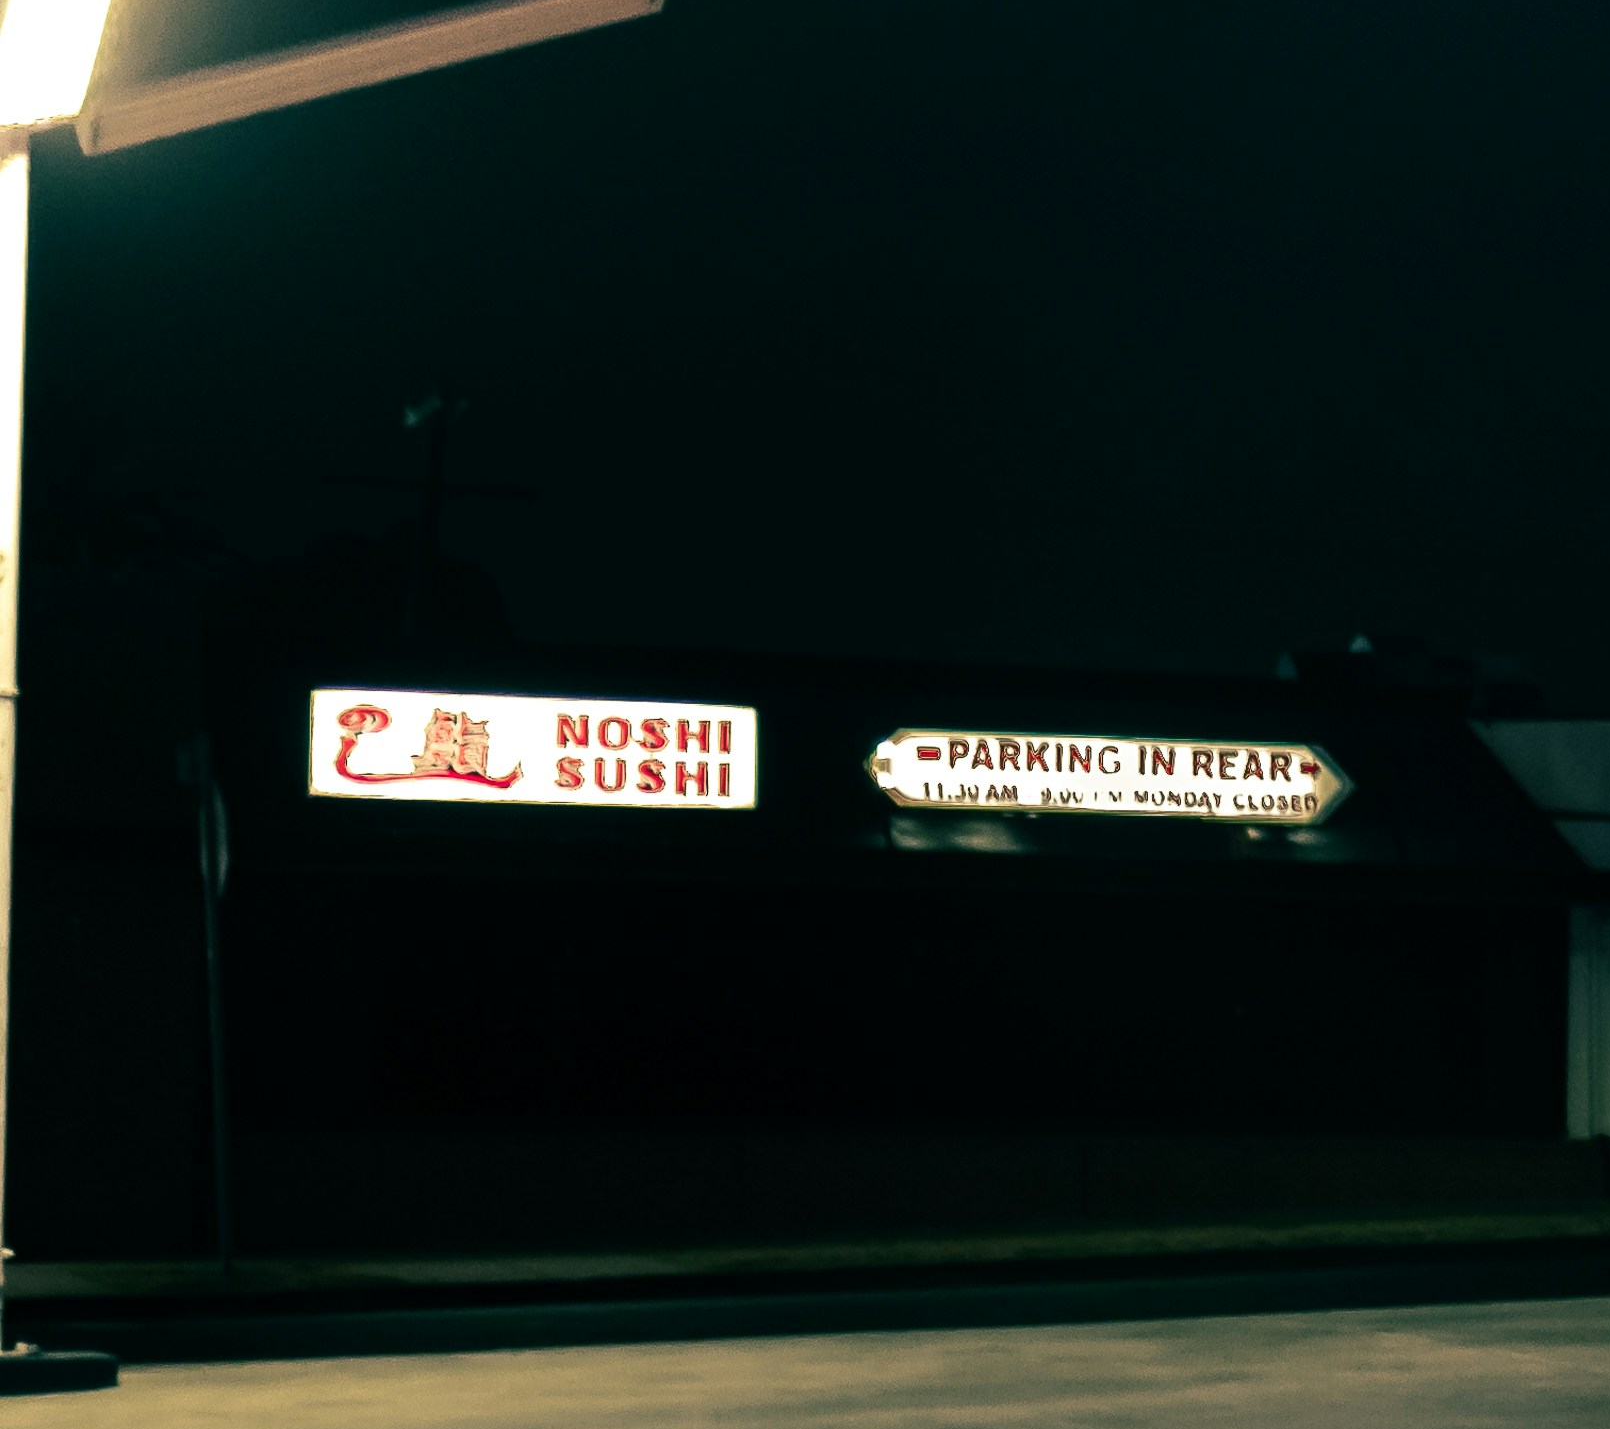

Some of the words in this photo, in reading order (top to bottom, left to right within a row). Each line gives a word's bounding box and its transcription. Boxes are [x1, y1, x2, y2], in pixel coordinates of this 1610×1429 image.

[556, 713, 732, 754] NOSHI
[553, 756, 731, 797] SUSHI
[949, 739, 1121, 774] PARKING
[1137, 745, 1176, 776] IN
[1192, 748, 1293, 782] REAR
[1134, 790, 1222, 810] MONDAY
[1232, 793, 1319, 814] CLOSED
